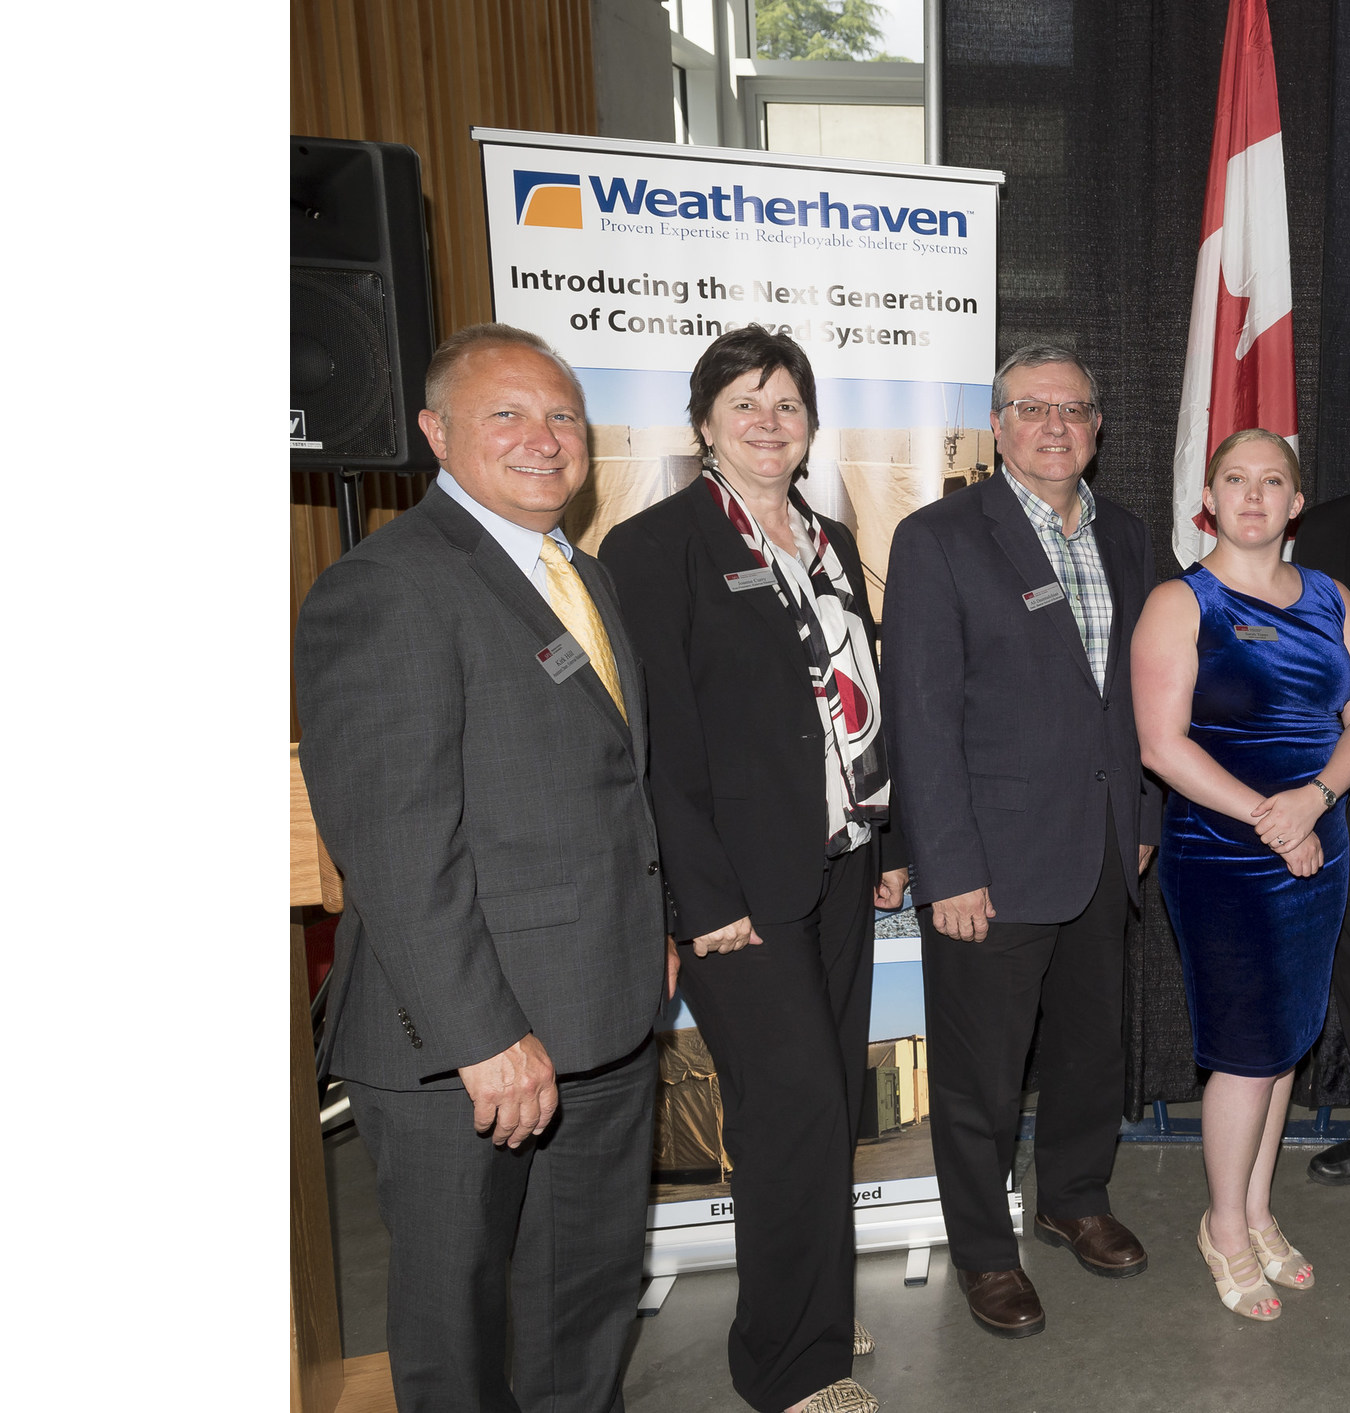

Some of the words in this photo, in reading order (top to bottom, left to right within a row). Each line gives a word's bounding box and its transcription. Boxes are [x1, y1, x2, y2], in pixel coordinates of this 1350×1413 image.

[588, 175, 968, 238] Weatherhaven
[600, 217, 654, 235] Proven
[660, 222, 730, 241] Expertise
[735, 227, 749, 241] in
[755, 229, 854, 249] Redeployable
[859, 236, 908, 252] Shelter
[912, 239, 968, 256] Systems
[510, 265, 689, 304] Introducing
[697, 276, 745, 300] the
[753, 280, 819, 306] Next
[826, 285, 978, 314] Generation
[570, 308, 600, 331] of
[607, 309, 811, 341] Containezed
[820, 320, 931, 349] Systems
